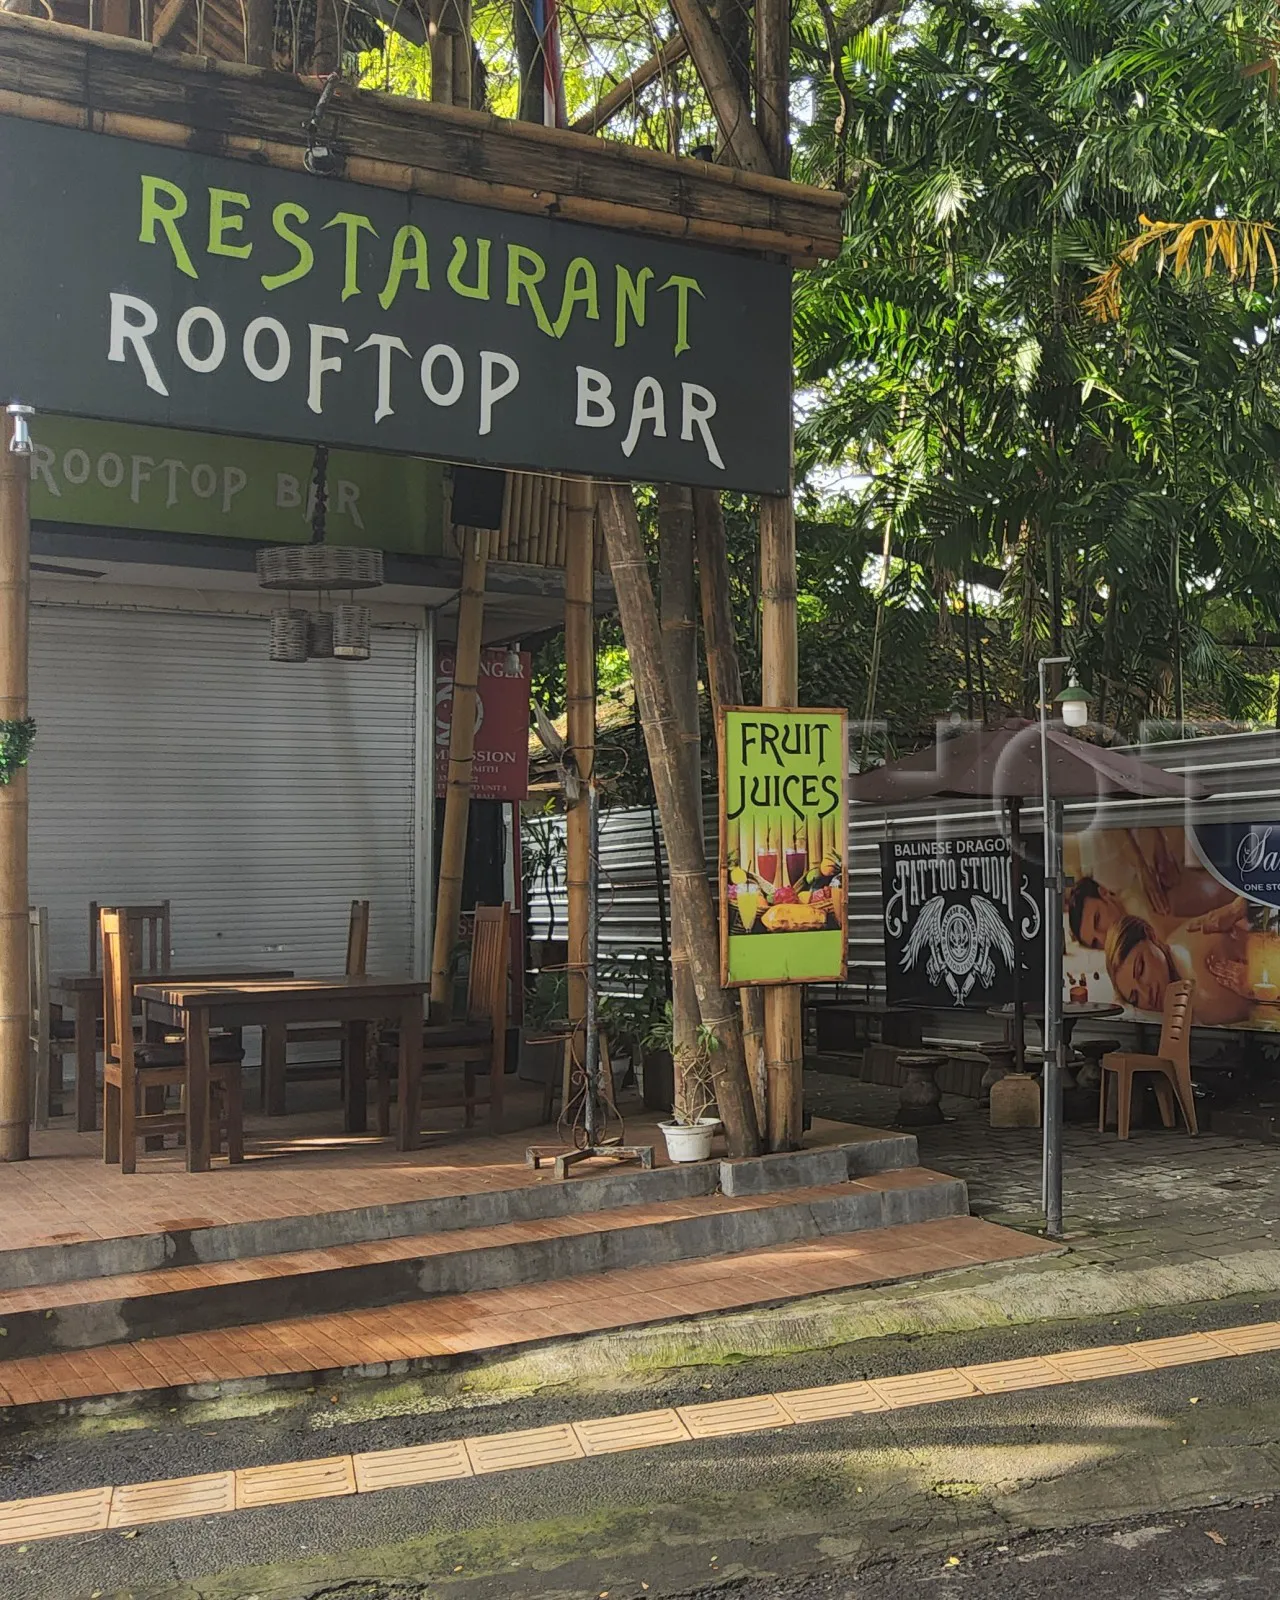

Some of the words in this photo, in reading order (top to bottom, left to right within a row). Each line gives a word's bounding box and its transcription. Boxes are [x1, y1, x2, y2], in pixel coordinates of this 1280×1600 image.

[138, 174, 706, 358] RESTAURANT
[107, 293, 520, 435] ROOFTOP
[575, 365, 727, 470] BAR
[30, 443, 248, 513] ROOFTOP
[740, 722, 832, 768] FRUIT
[727, 774, 840, 822] JUICES
[894, 841, 953, 857] BALINESE
[894, 859, 957, 923] TATTOO
[1244, 883, 1264, 892] ONE
